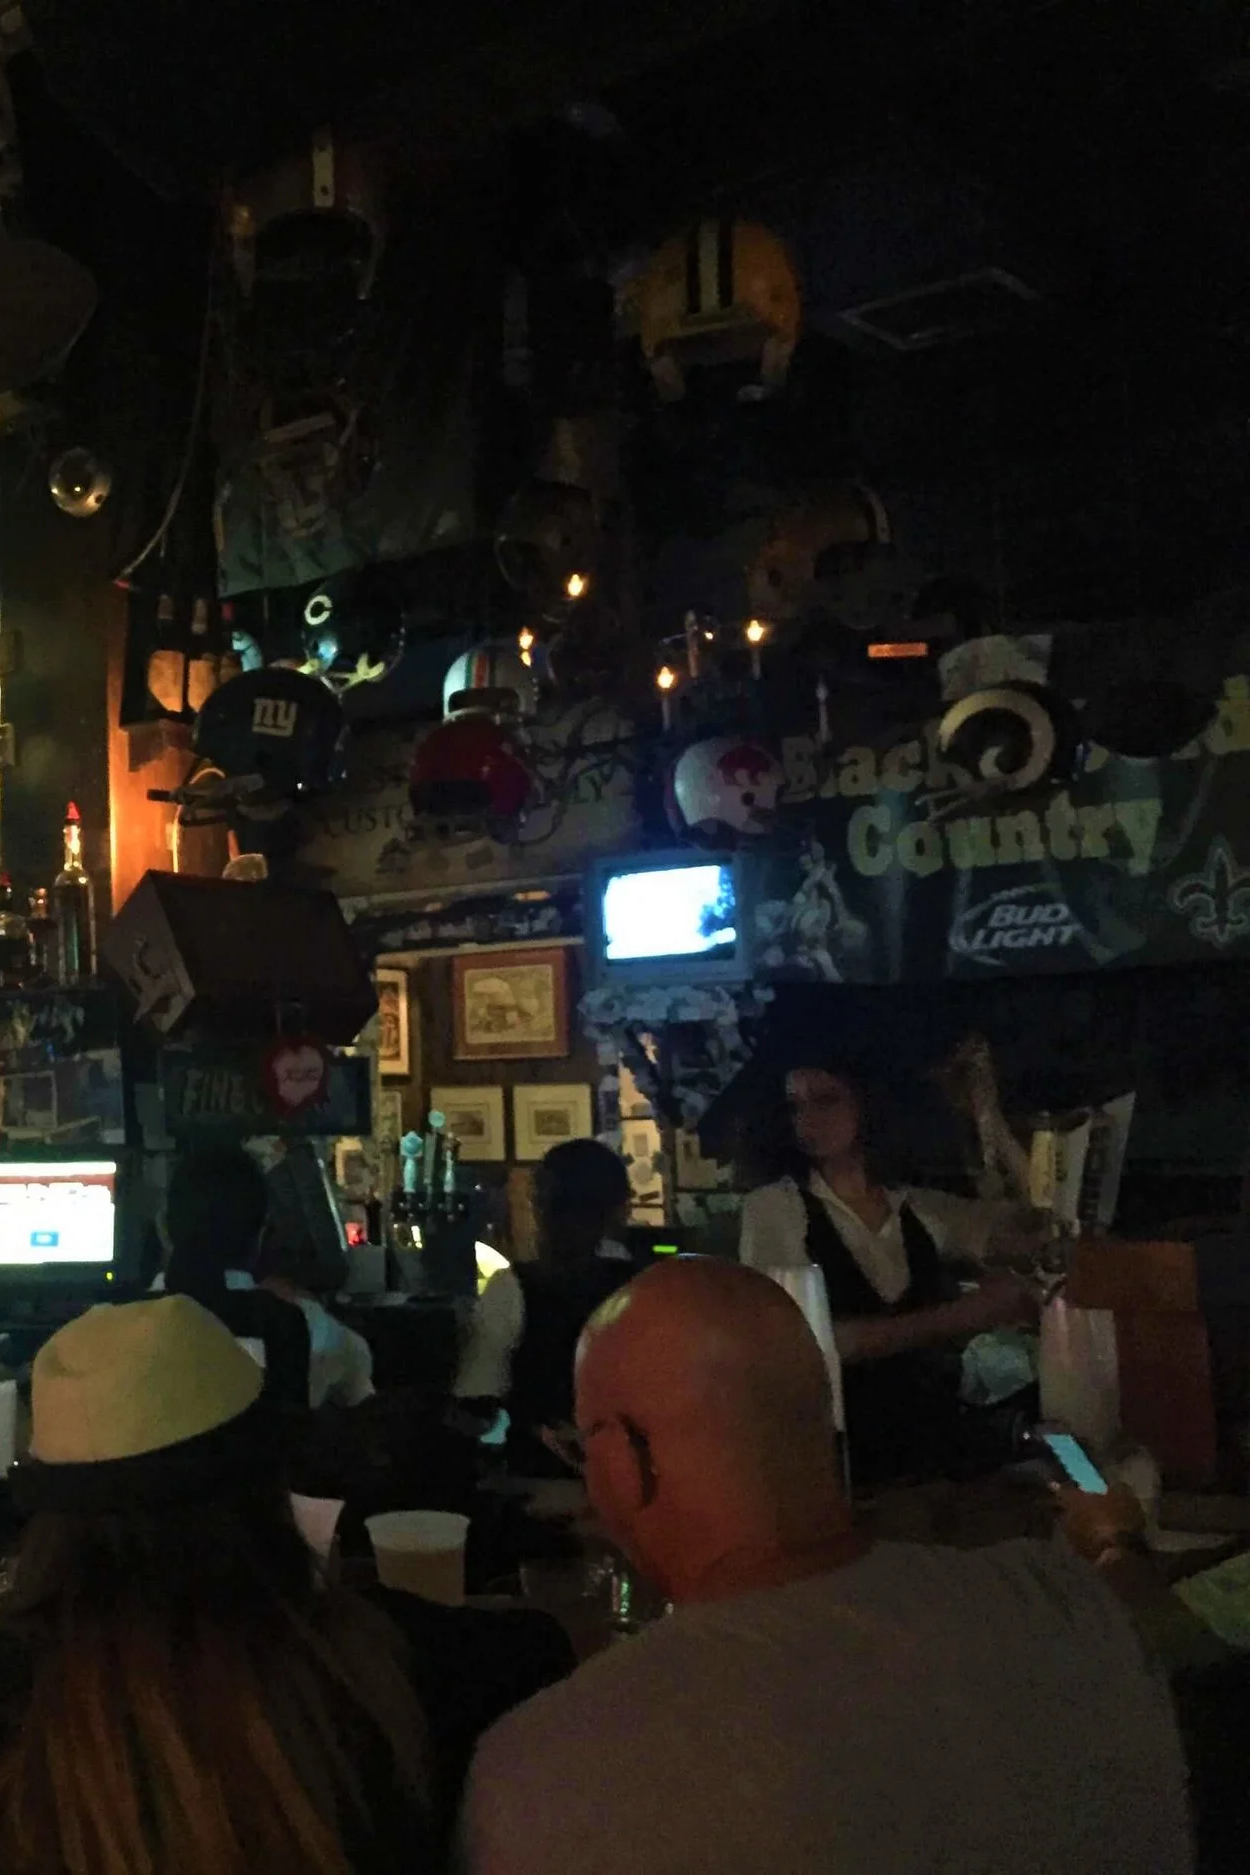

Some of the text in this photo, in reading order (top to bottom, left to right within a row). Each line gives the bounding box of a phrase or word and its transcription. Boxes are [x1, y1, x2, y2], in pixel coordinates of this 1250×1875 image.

[847, 790, 1162, 878] Country
[987, 903, 1071, 927] BUD
[971, 924, 1083, 949] LIGHT
